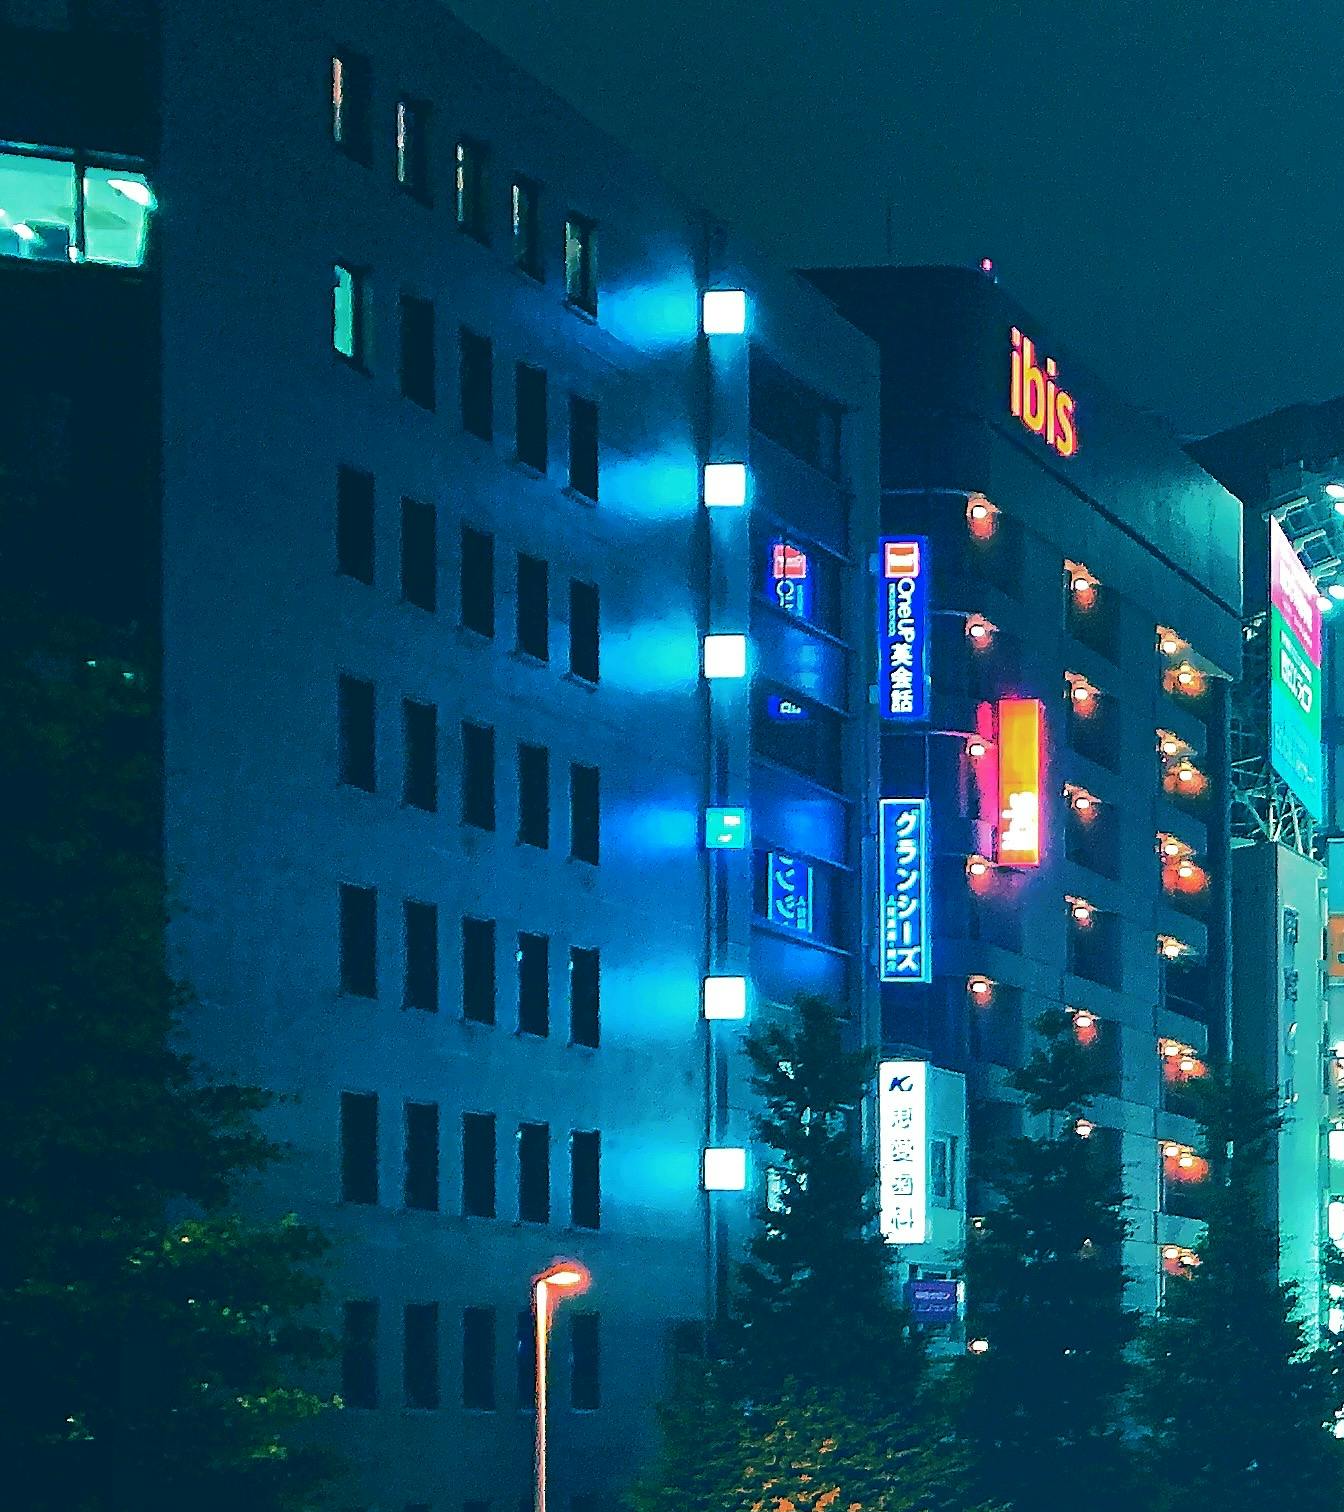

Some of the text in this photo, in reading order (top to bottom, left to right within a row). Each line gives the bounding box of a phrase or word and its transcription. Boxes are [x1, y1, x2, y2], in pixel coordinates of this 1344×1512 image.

[1012, 326, 1077, 456] ibis
[896, 808, 921, 971] グランシーズ
